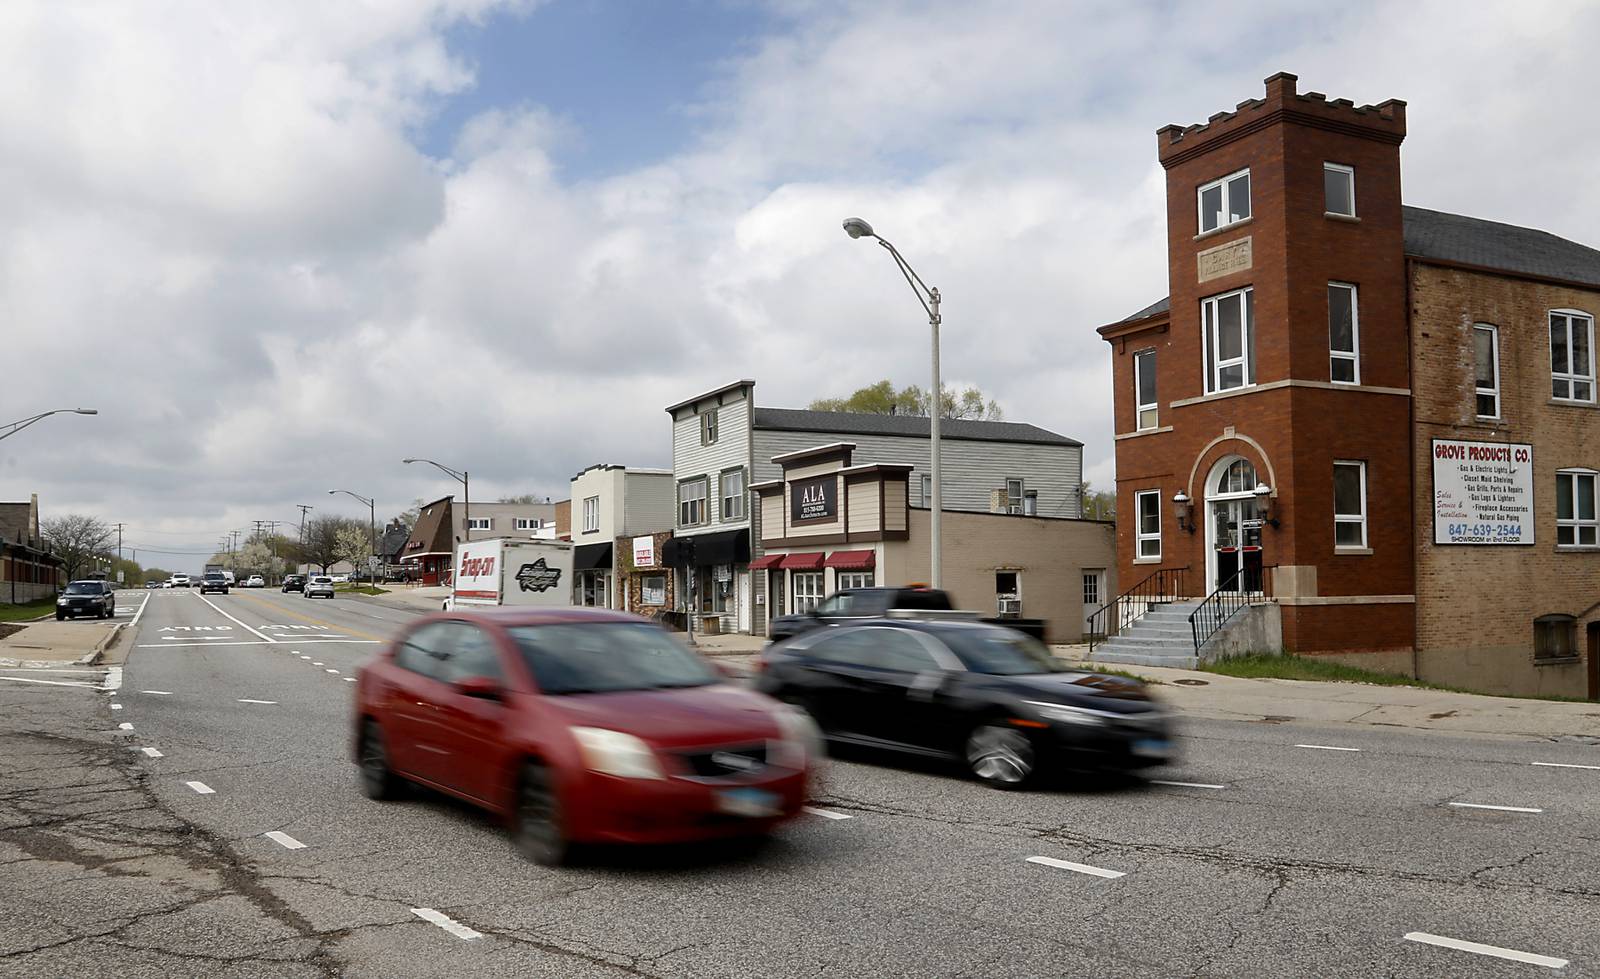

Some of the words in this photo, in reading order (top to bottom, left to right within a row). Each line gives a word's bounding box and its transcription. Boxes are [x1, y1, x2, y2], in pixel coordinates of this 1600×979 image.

[1435, 444, 1465, 460] GROVE
[1469, 446, 1511, 462] PRODUCTS
[1515, 448, 1530, 463] CO.
[1460, 464, 1469, 472] Gas
[1475, 465, 1493, 473] Electric
[1494, 466, 1508, 474] Lights
[1463, 474, 1479, 482] Closet
[1493, 476, 1513, 485] Shelving
[802, 484, 825, 503] ALA
[1467, 484, 1475, 492] Gas
[1490, 485, 1502, 493] Parts
[1507, 486, 1523, 494] Repairs
[1481, 494, 1491, 502] Logs
[1497, 495, 1515, 503] Lighters
[1437, 501, 1456, 509] Service
[1475, 504, 1498, 512] Fireplace
[1499, 505, 1528, 513] Accessories
[1437, 510, 1468, 518] Installation
[1479, 513, 1495, 521] Natural
[1506, 514, 1519, 522] Piping
[1448, 523, 1522, 536] 847-639-2544
[460, 552, 495, 582] Snap-on
